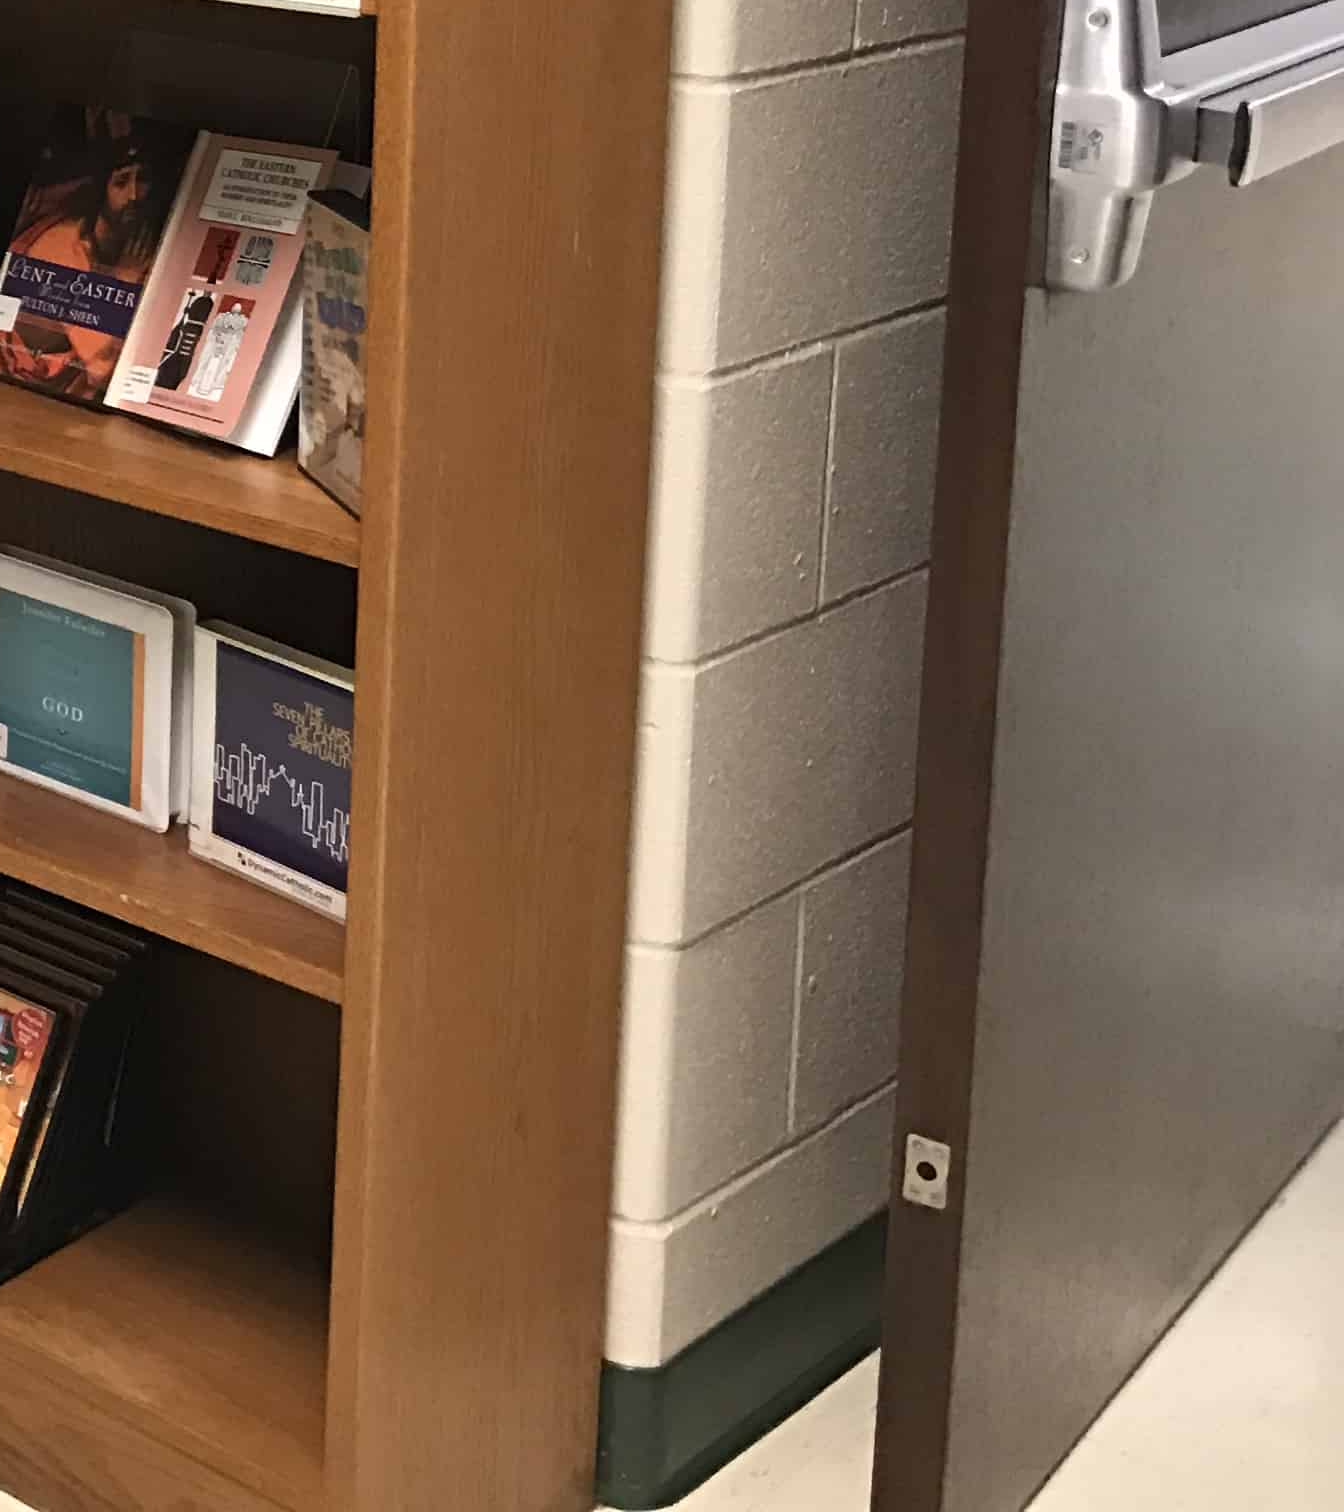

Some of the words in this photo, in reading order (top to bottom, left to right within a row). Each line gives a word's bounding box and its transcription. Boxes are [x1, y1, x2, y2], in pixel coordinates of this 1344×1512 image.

[7, 258, 55, 287] LENT
[69, 272, 135, 308] EASTER
[69, 306, 100, 327] SHEEN
[42, 695, 84, 723] GOD
